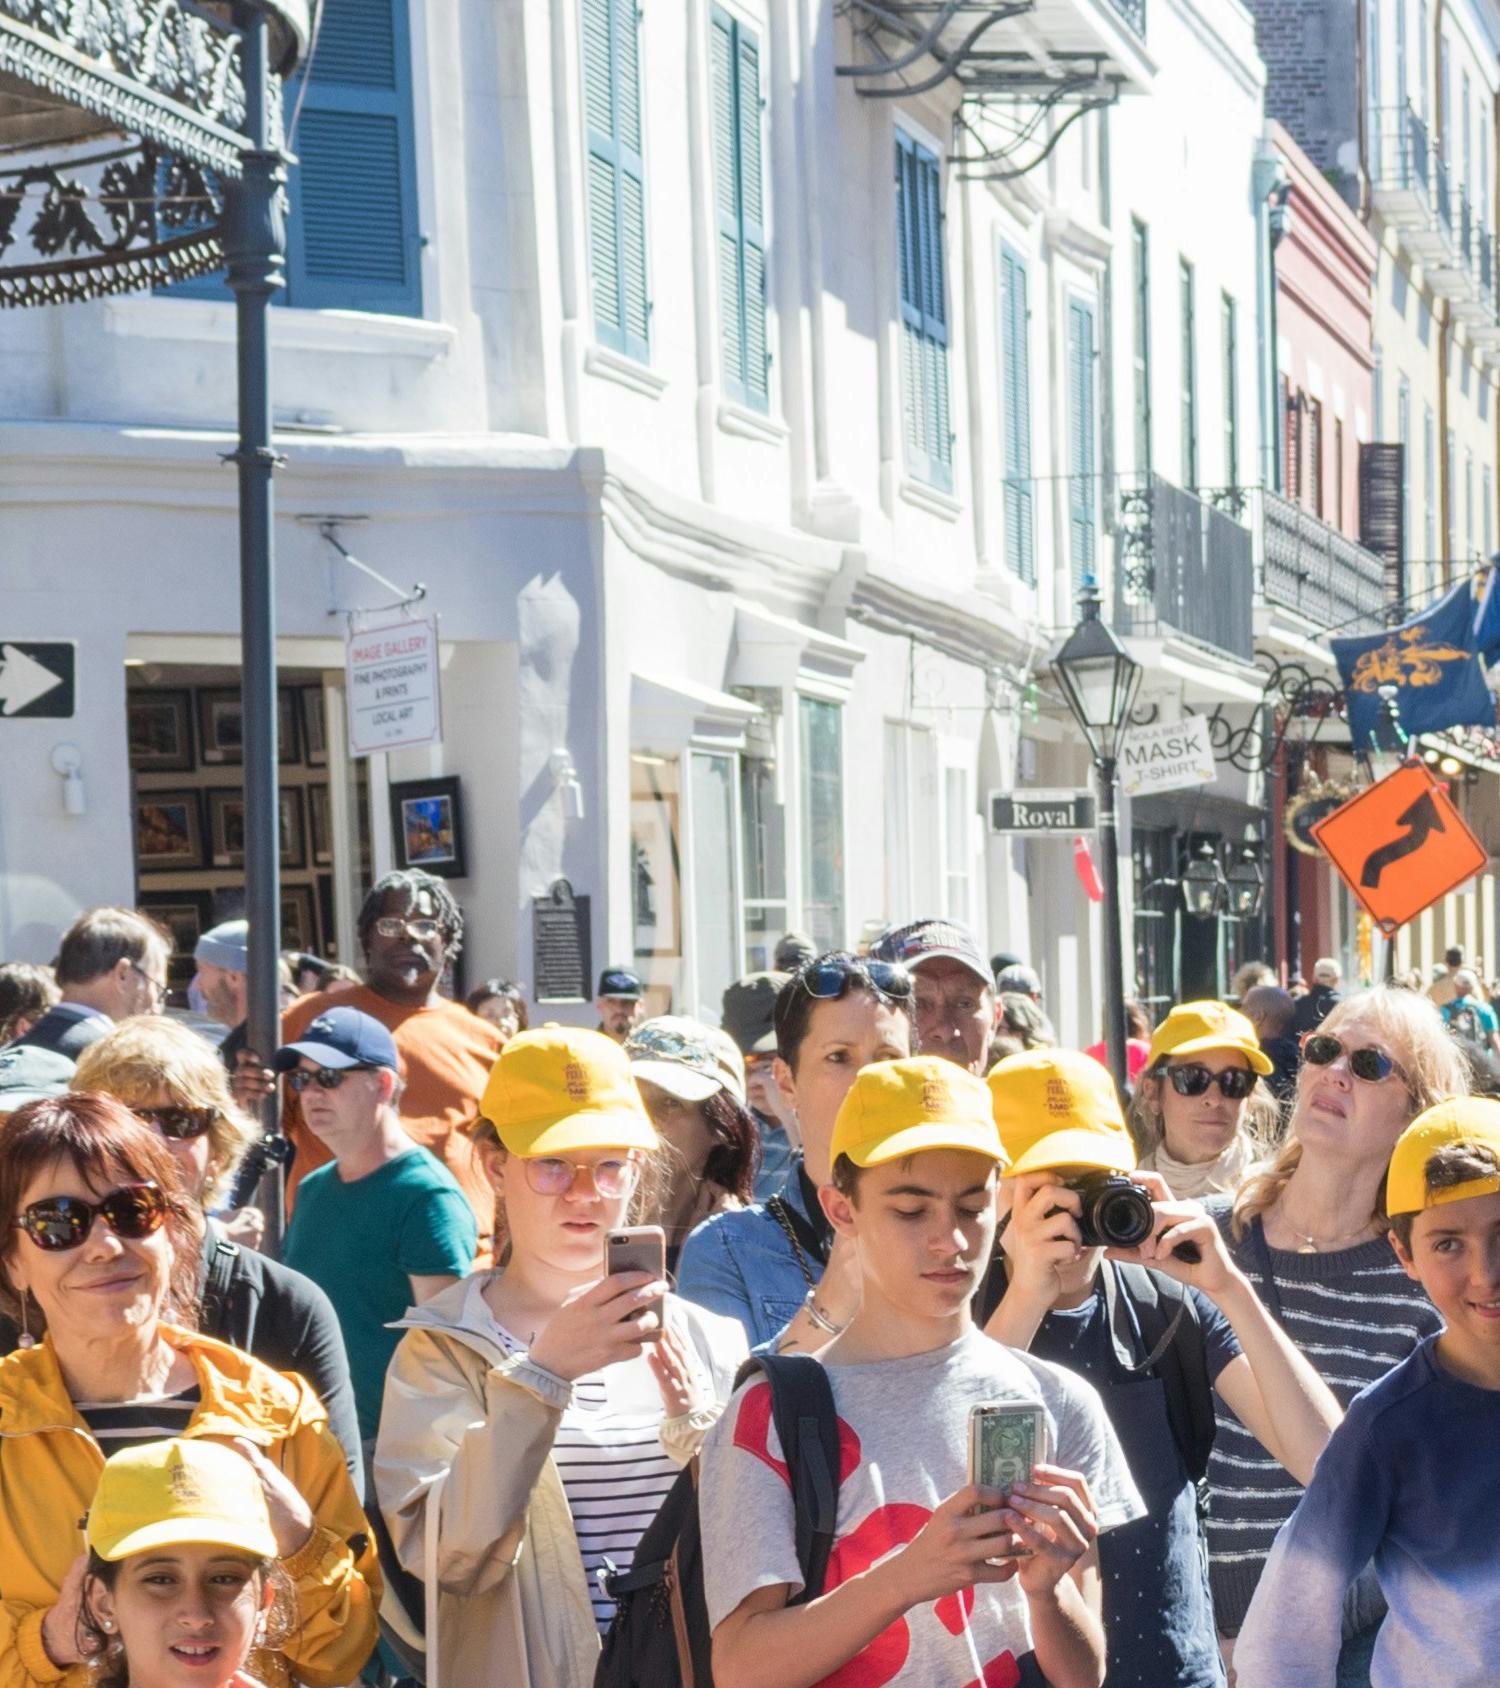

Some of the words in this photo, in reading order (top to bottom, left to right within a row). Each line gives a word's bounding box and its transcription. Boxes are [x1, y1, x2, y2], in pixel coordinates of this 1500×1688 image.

[353, 644, 382, 661] IMAGE
[384, 636, 427, 657] GALLERY
[354, 671, 371, 685] FINE
[372, 661, 427, 682] PHOTOGRAPHY
[372, 710, 397, 725] LOCAL
[399, 706, 414, 719] ART
[1162, 723, 1189, 735] BEST
[1125, 734, 1202, 766] MASK
[1134, 760, 1196, 783] T-SHIRT
[1012, 803, 1076, 829] Royal
